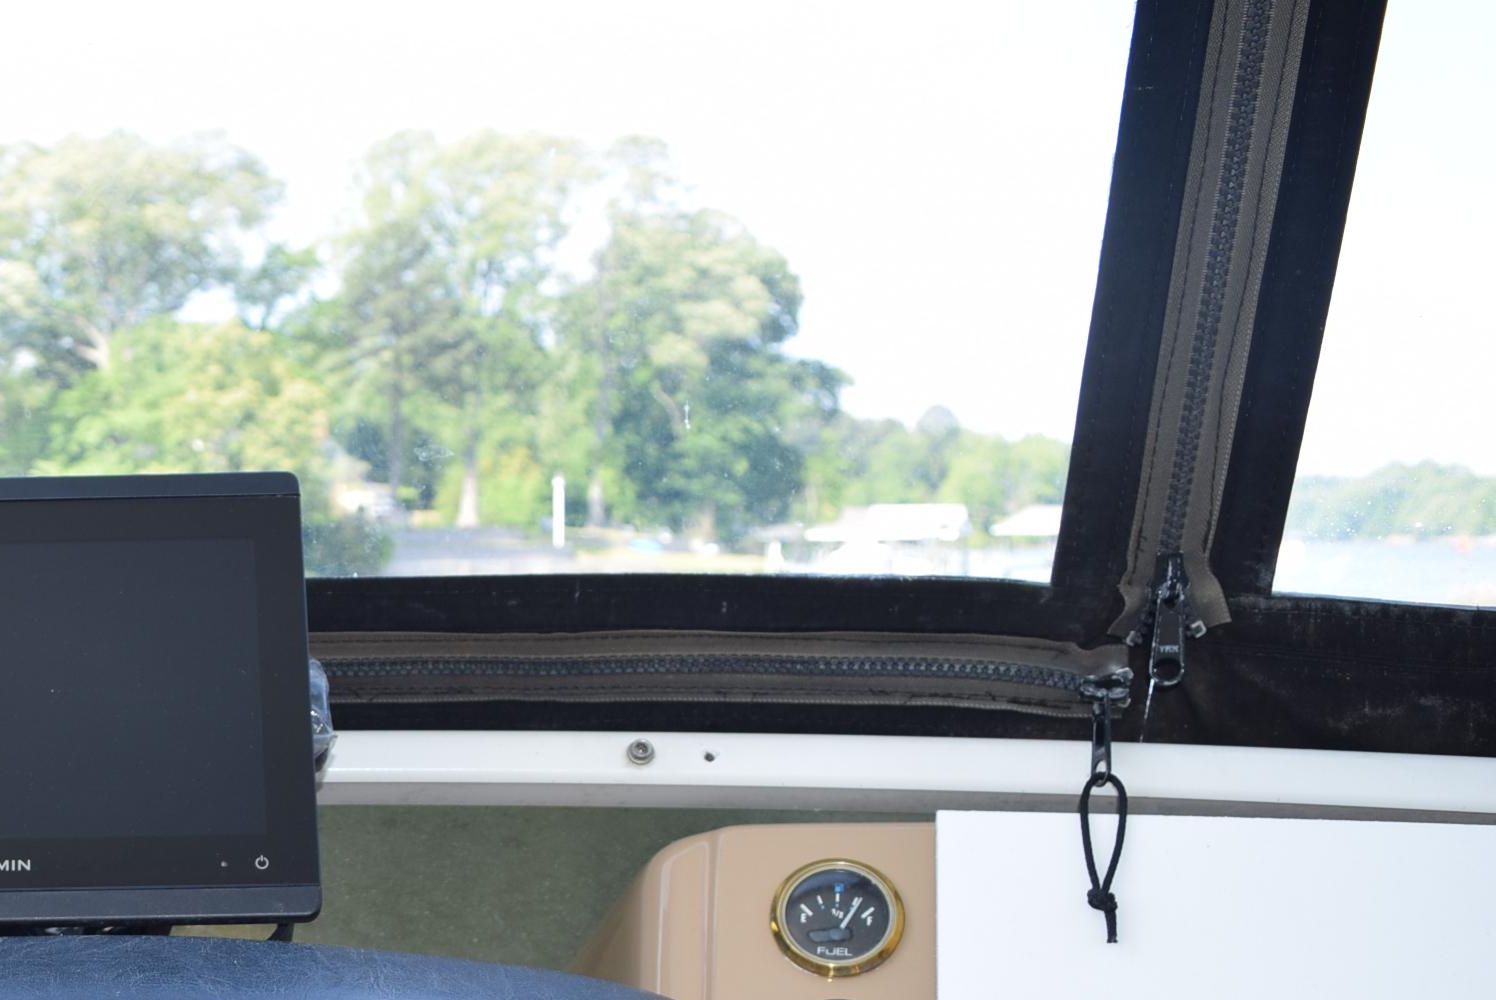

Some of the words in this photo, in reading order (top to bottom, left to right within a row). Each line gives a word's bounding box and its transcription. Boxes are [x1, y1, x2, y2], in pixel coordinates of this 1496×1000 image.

[800, 913, 808, 923] E
[865, 916, 874, 927] F
[816, 946, 853, 957] FUEL
